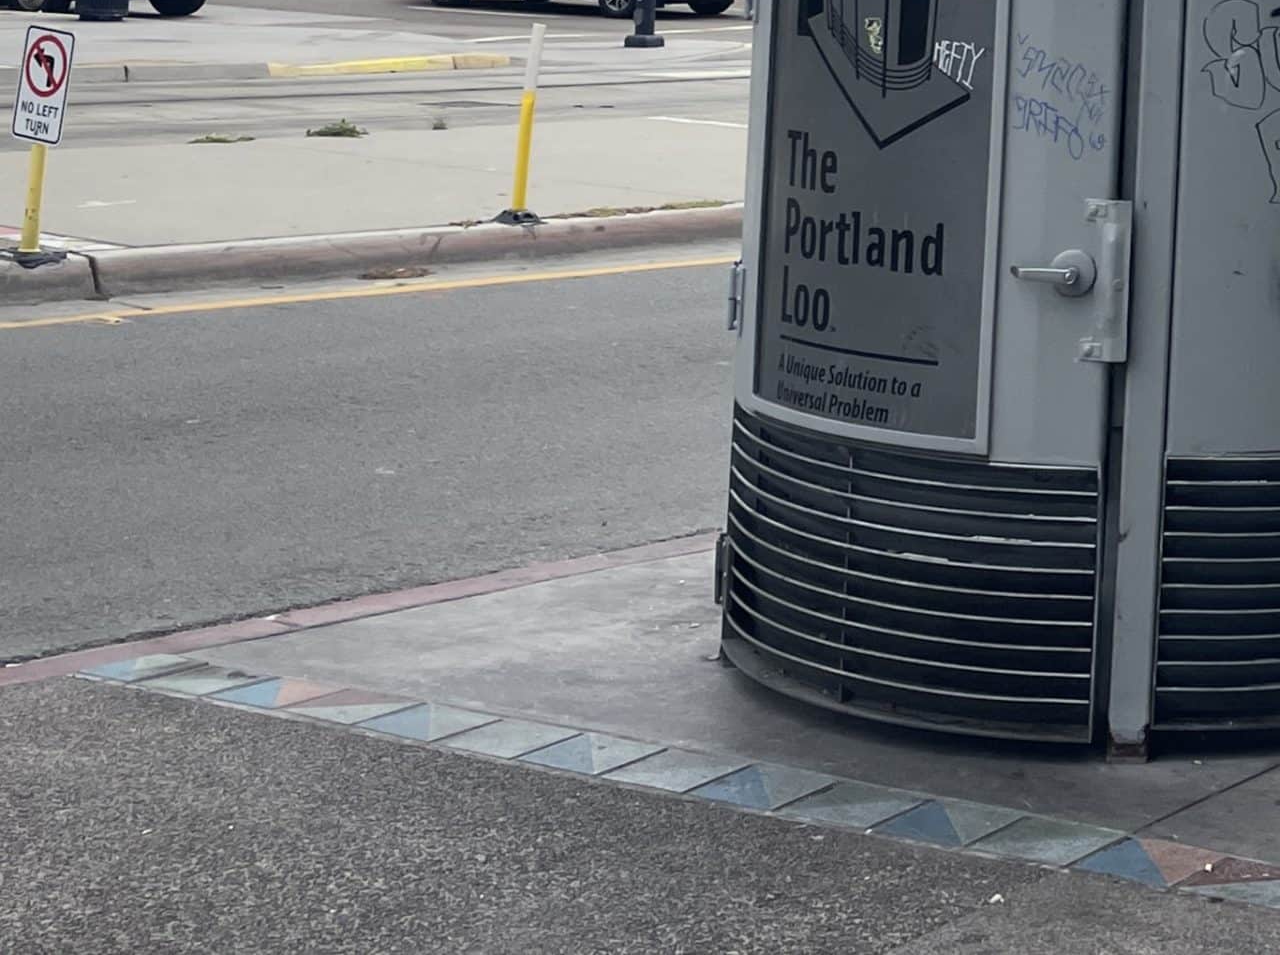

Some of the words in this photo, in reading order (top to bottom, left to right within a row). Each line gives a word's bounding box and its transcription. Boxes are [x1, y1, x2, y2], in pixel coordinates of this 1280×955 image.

[21, 100, 34, 114] NO
[36, 103, 59, 119] LEFT
[25, 118, 50, 135] TURN
[787, 130, 838, 194] The
[784, 197, 945, 276] Portland
[777, 352, 785, 372] A
[786, 354, 826, 385] Unique
[827, 364, 888, 394] Solution
[890, 376, 907, 397] to
[910, 382, 922, 398] a
[828, 393, 890, 423] Problem
